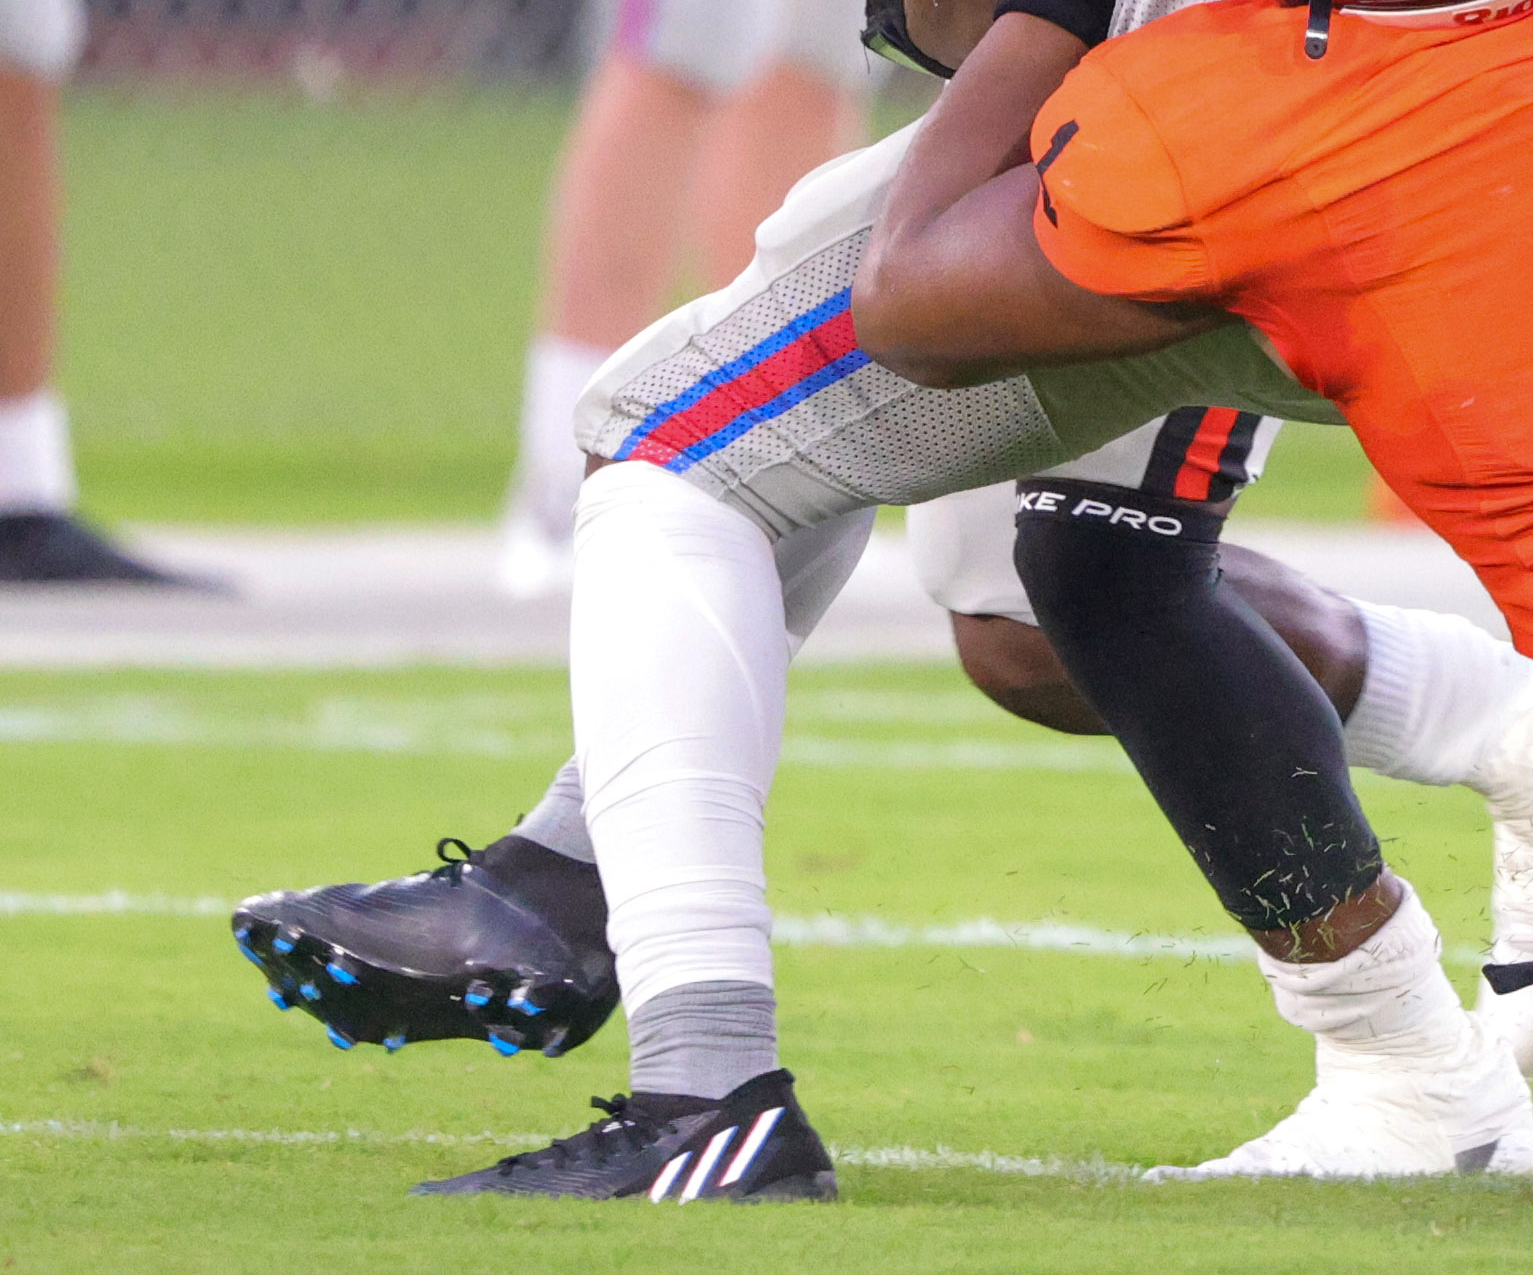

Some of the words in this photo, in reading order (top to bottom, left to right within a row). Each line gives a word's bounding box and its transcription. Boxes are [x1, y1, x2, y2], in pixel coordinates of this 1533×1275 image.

[1036, 119, 1080, 229] 1
[1018, 491, 1067, 513] KE
[1071, 498, 1183, 537] PRO
